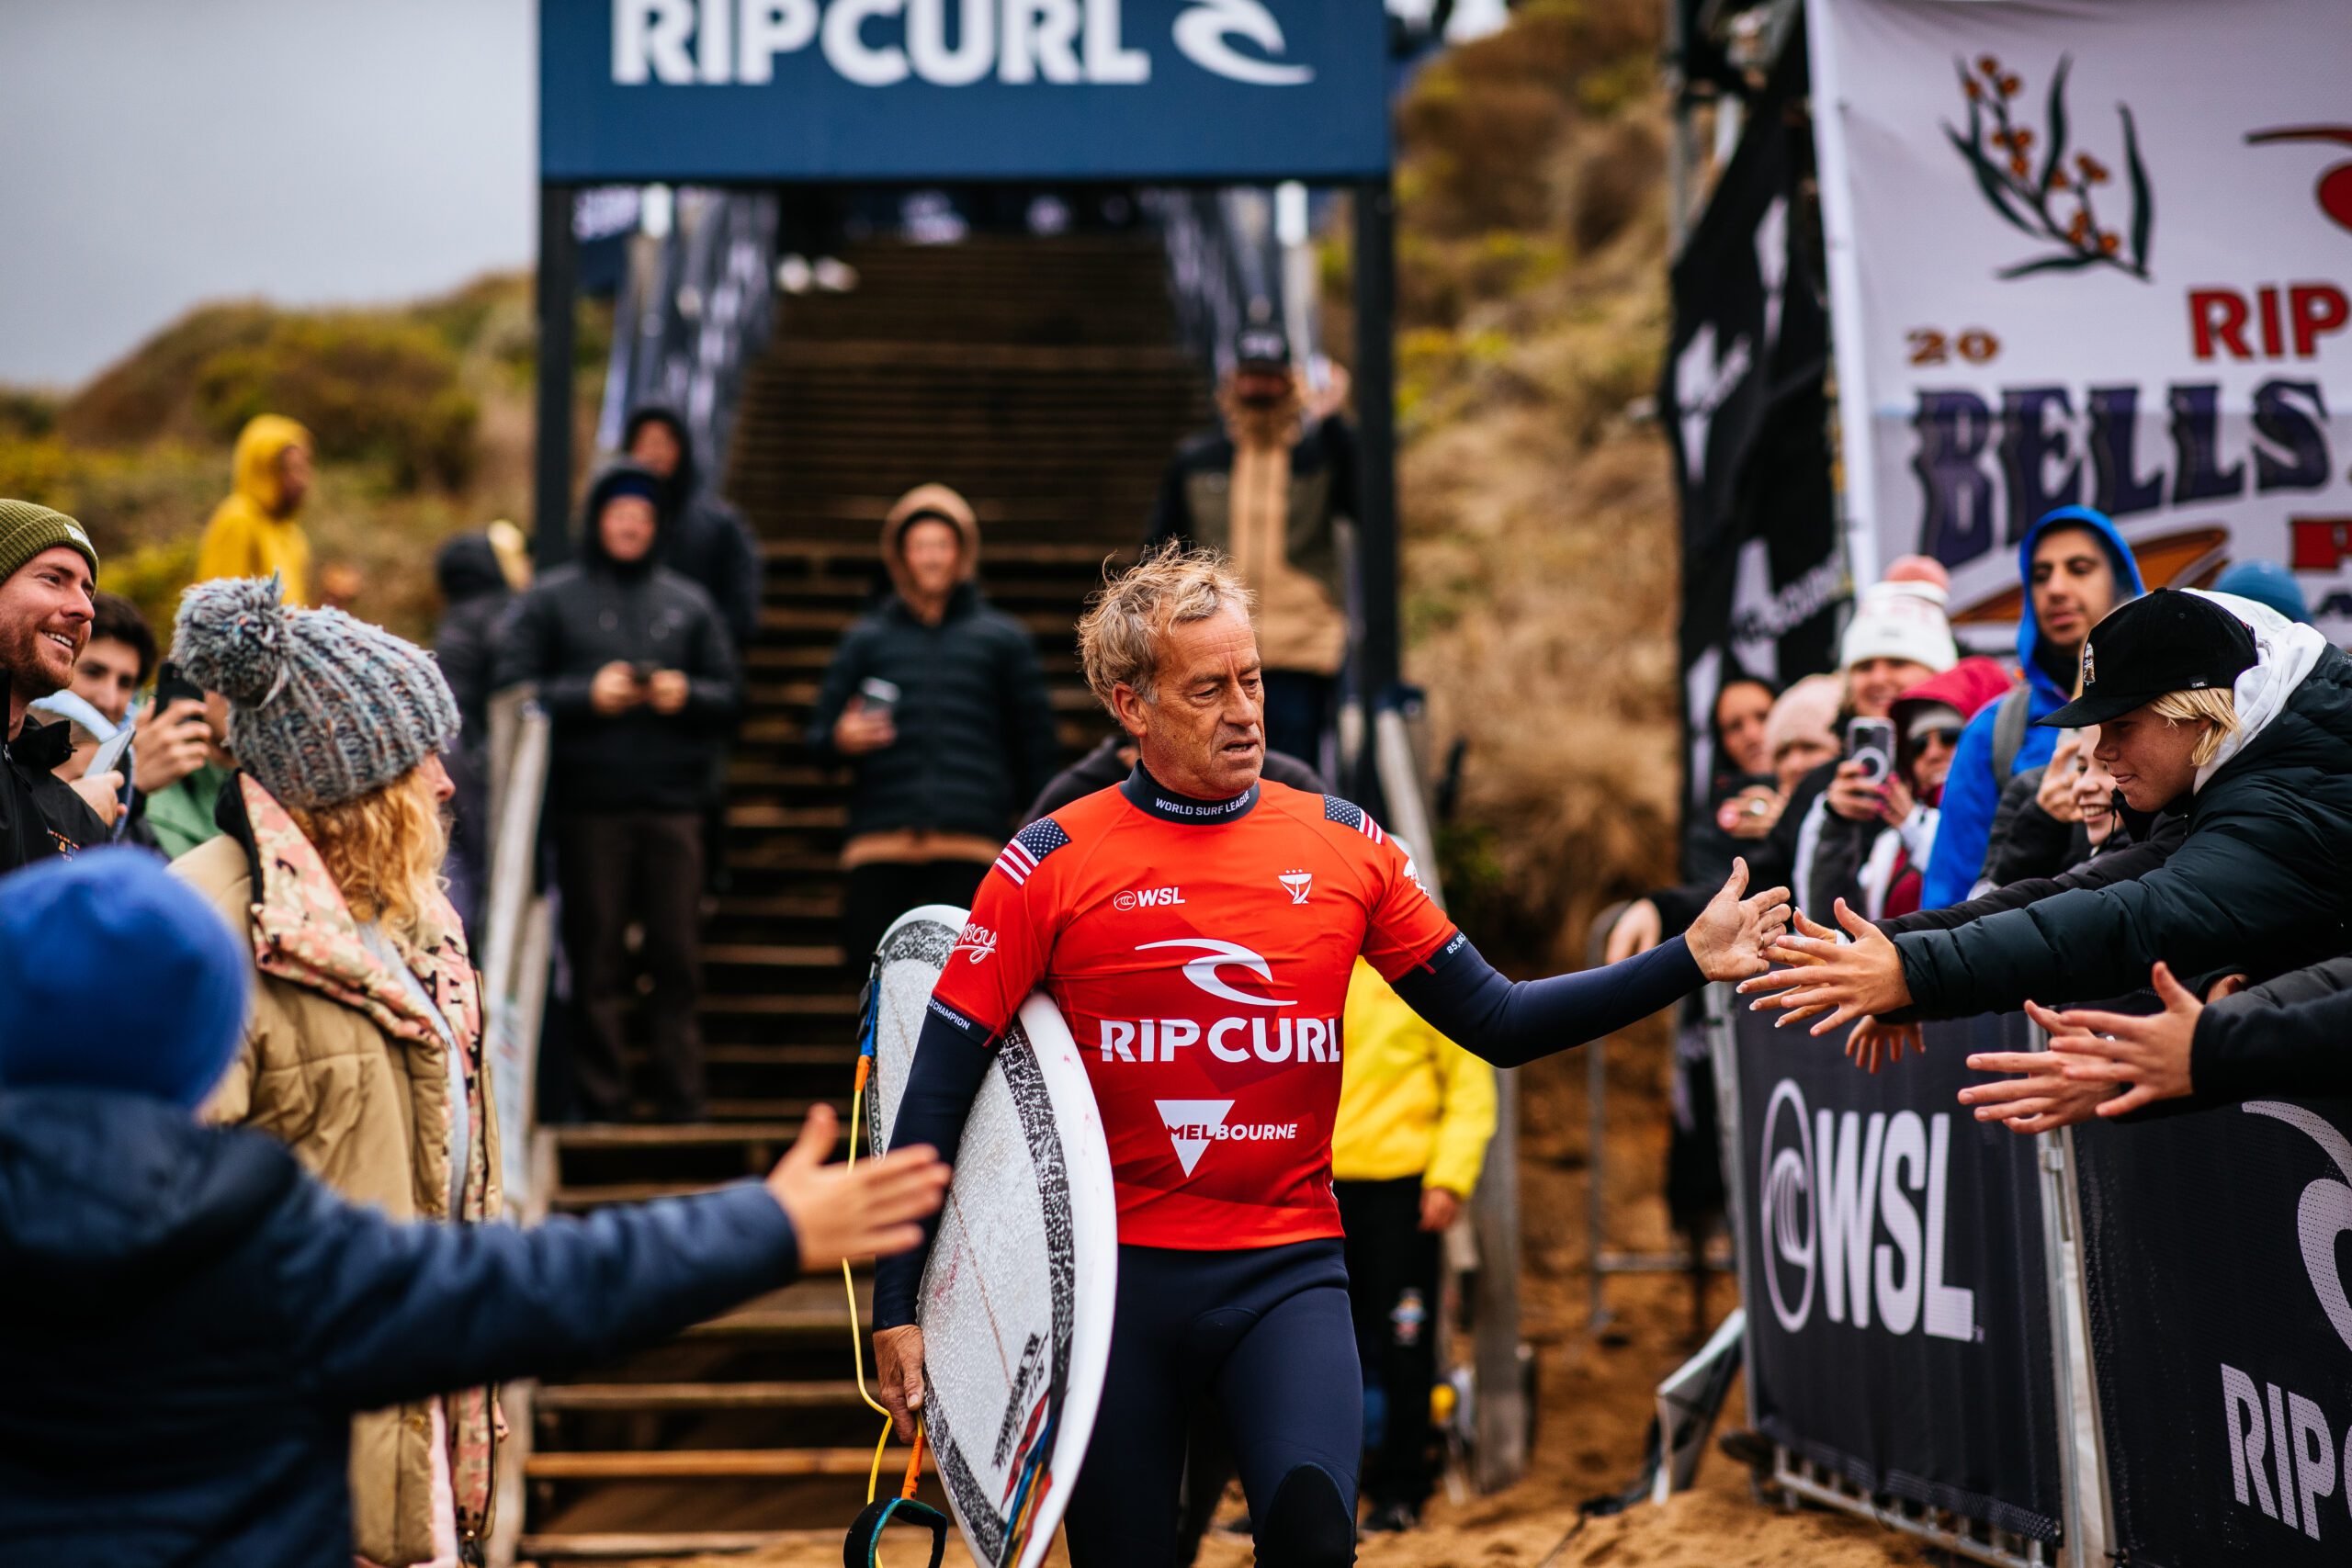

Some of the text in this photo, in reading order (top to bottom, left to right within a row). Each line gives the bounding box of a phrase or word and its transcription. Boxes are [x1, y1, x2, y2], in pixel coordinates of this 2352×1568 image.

[2188, 282, 2350, 361] RIP
[1905, 328, 2001, 366] 20
[1911, 378, 2331, 571] BELLS
[1156, 789, 1250, 816] WORLD SURF LEAGUE
[1136, 886, 1186, 908] WSL
[933, 1001, 971, 1030] CHAMPION
[1100, 1016, 1340, 1063] RIP CURL
[1167, 1123, 1298, 1141] MELBOURNE
[1815, 1109, 1973, 1342] WSL
[2221, 1362, 2336, 1541] RIP
